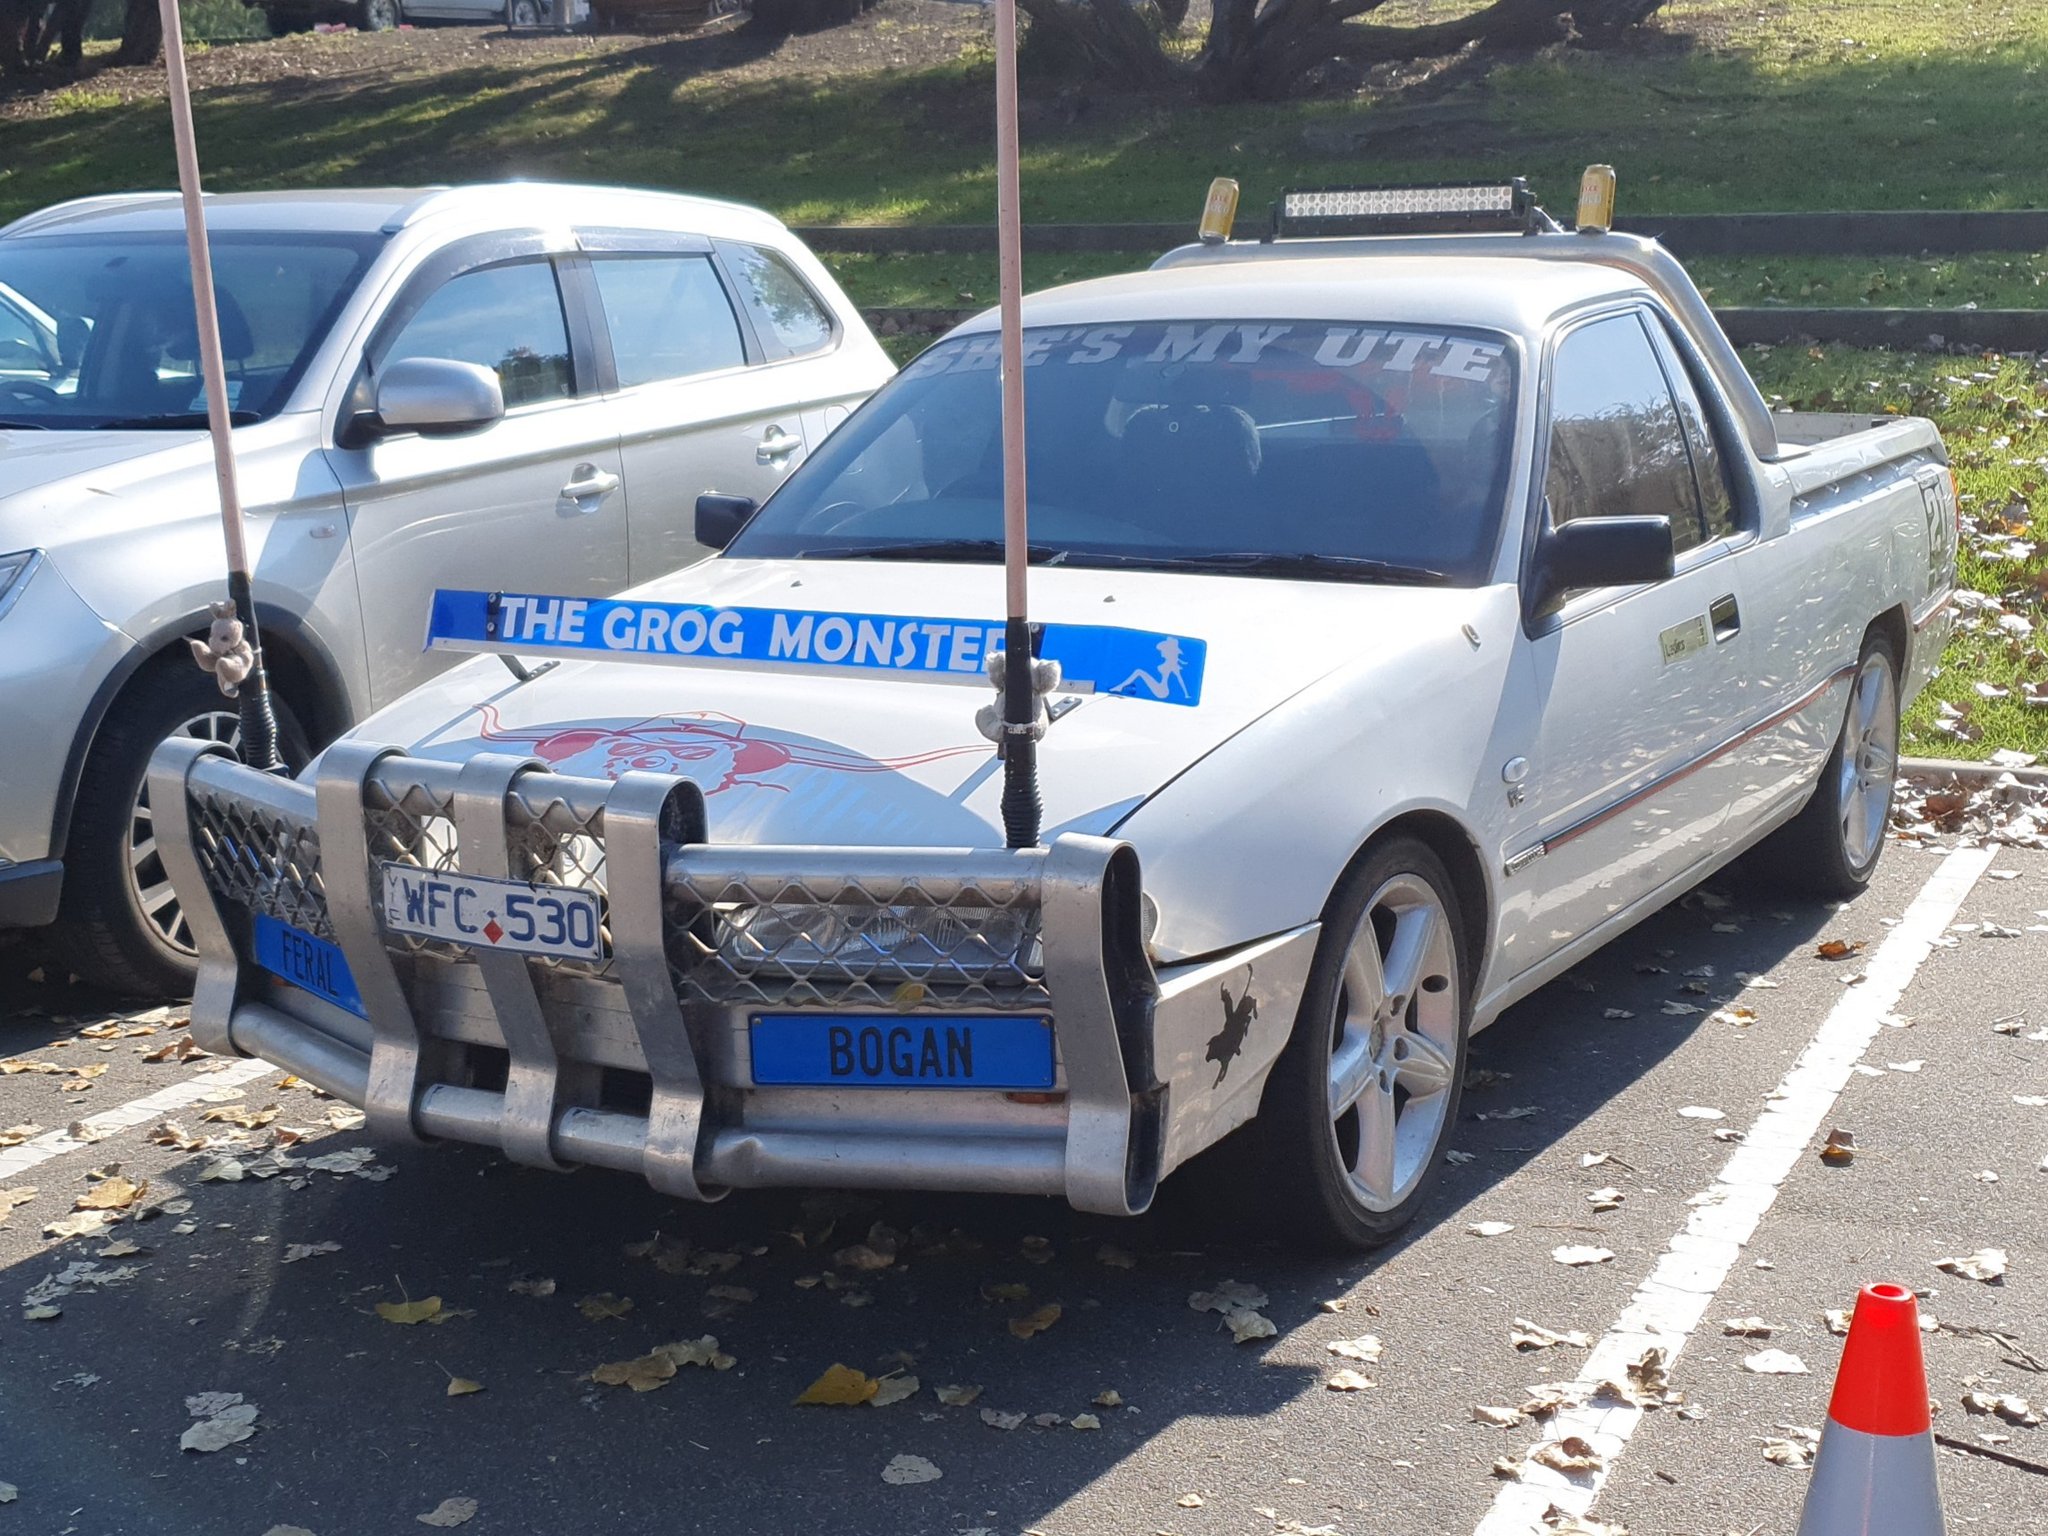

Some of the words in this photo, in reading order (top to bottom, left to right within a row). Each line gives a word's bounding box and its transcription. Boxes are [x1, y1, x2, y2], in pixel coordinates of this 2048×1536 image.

[1145, 325, 1292, 364] MY
[1313, 327, 1505, 382] UTE
[500, 597, 588, 643] THE
[603, 606, 744, 655] GROG
[387, 875, 401, 922] VIC
[282, 929, 338, 997] FERAL
[829, 1026, 973, 1078] BOGAN
